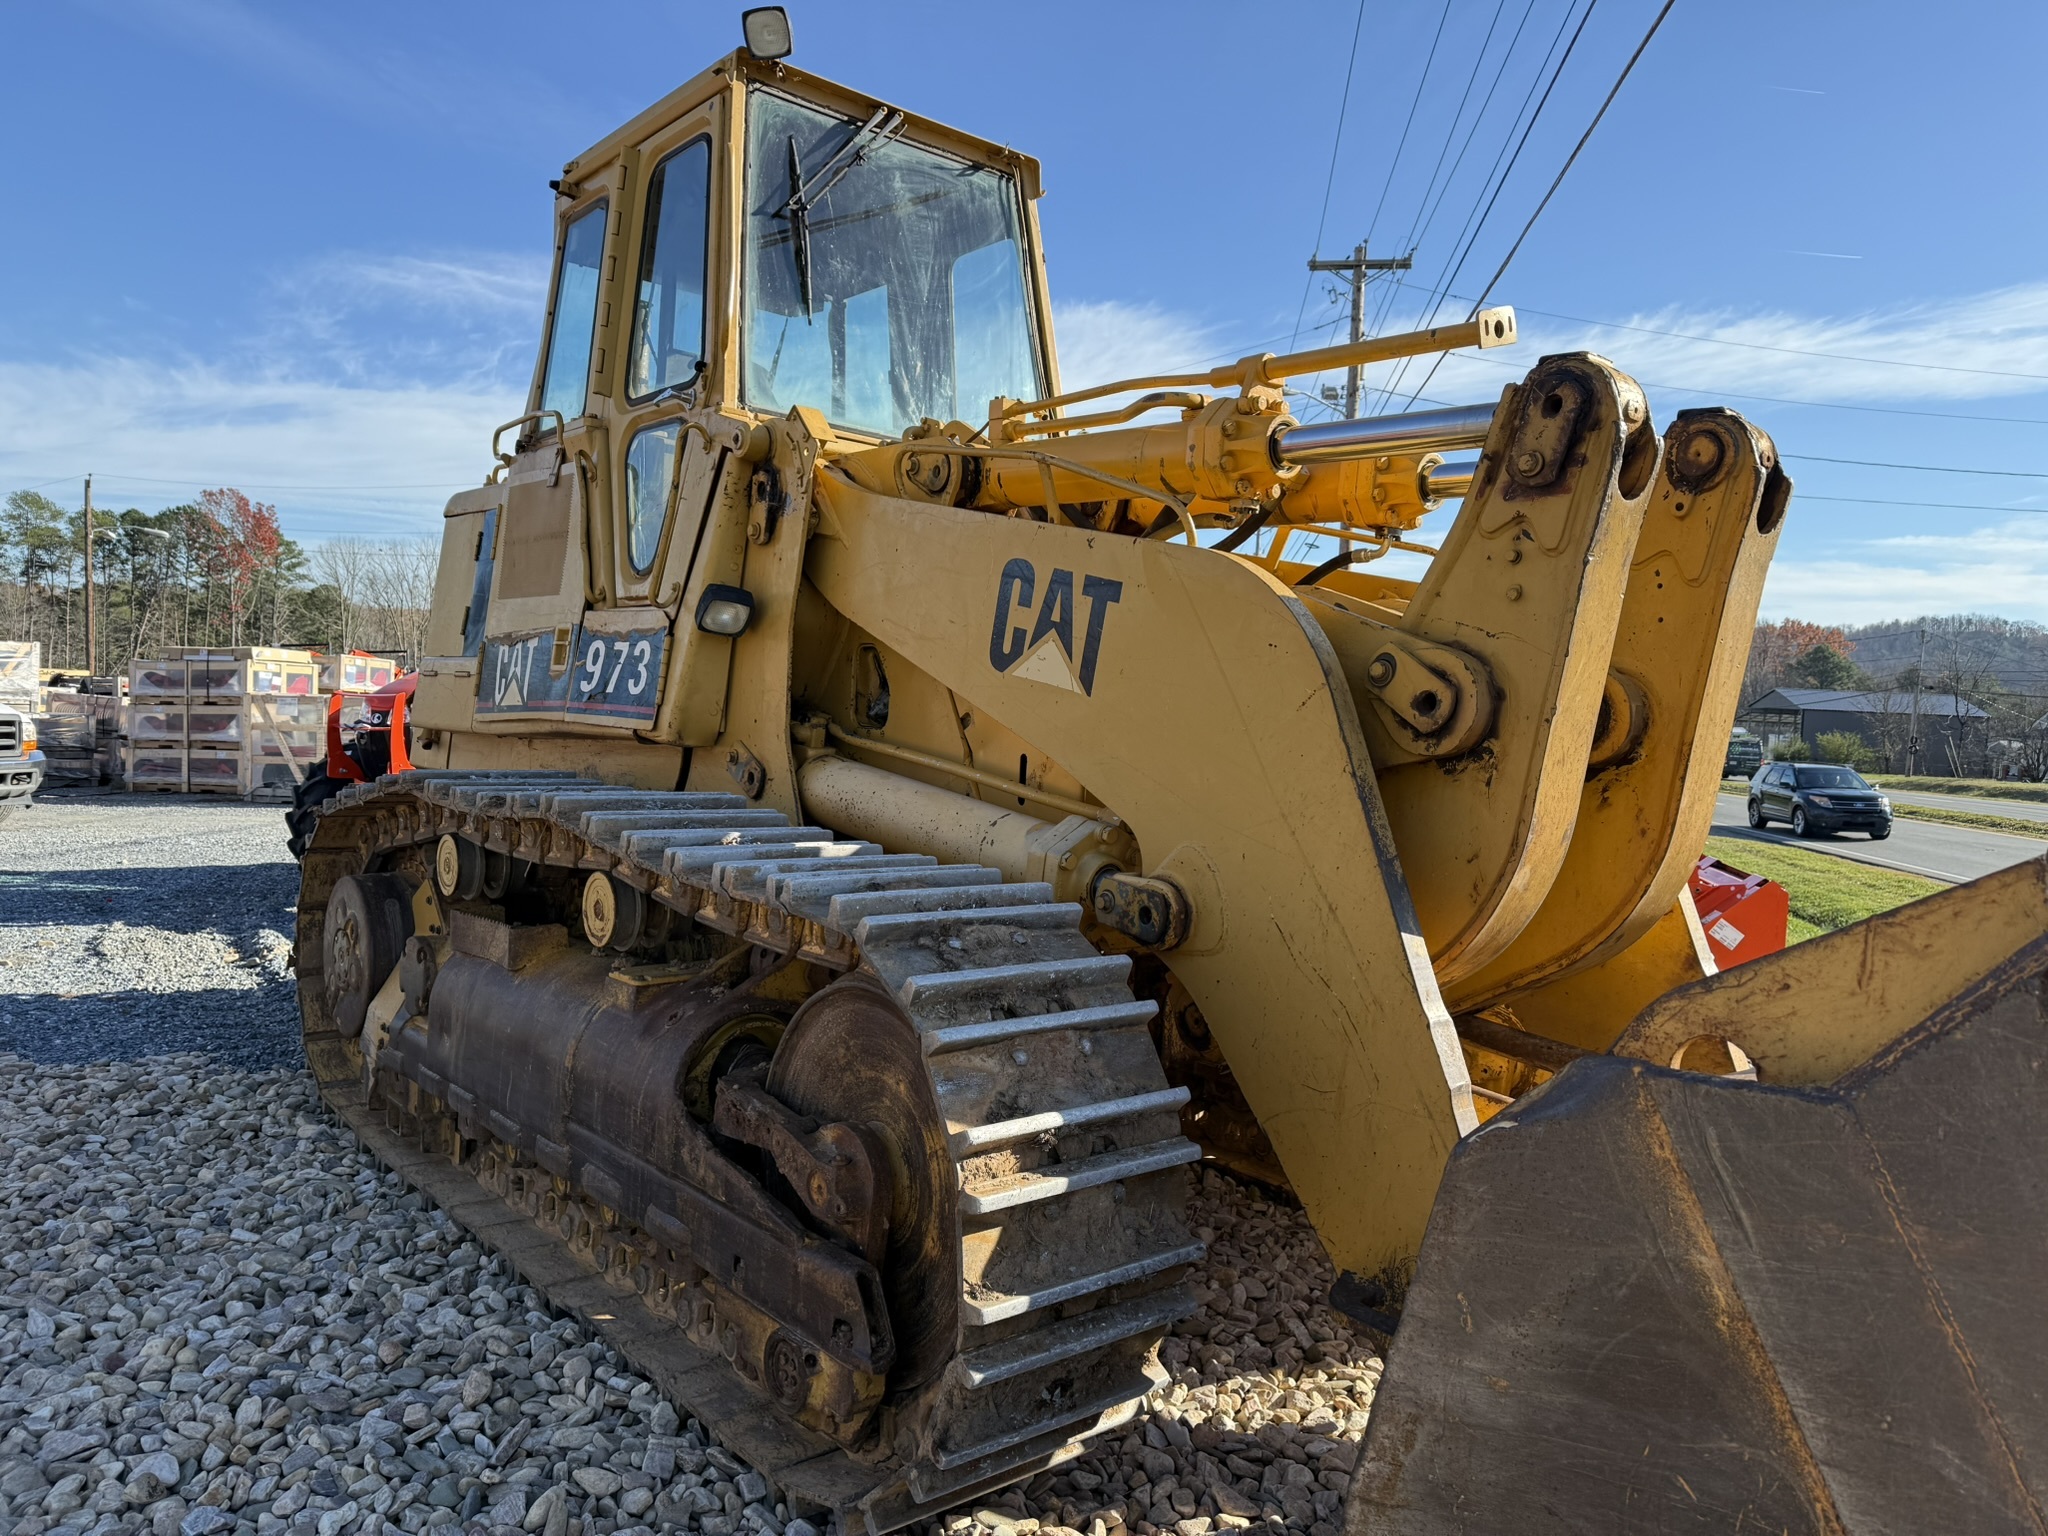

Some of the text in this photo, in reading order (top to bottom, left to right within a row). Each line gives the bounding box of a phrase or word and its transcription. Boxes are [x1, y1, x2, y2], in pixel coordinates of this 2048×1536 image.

[494, 637, 651, 705] CAT 973
[989, 557, 1123, 698] CAT
